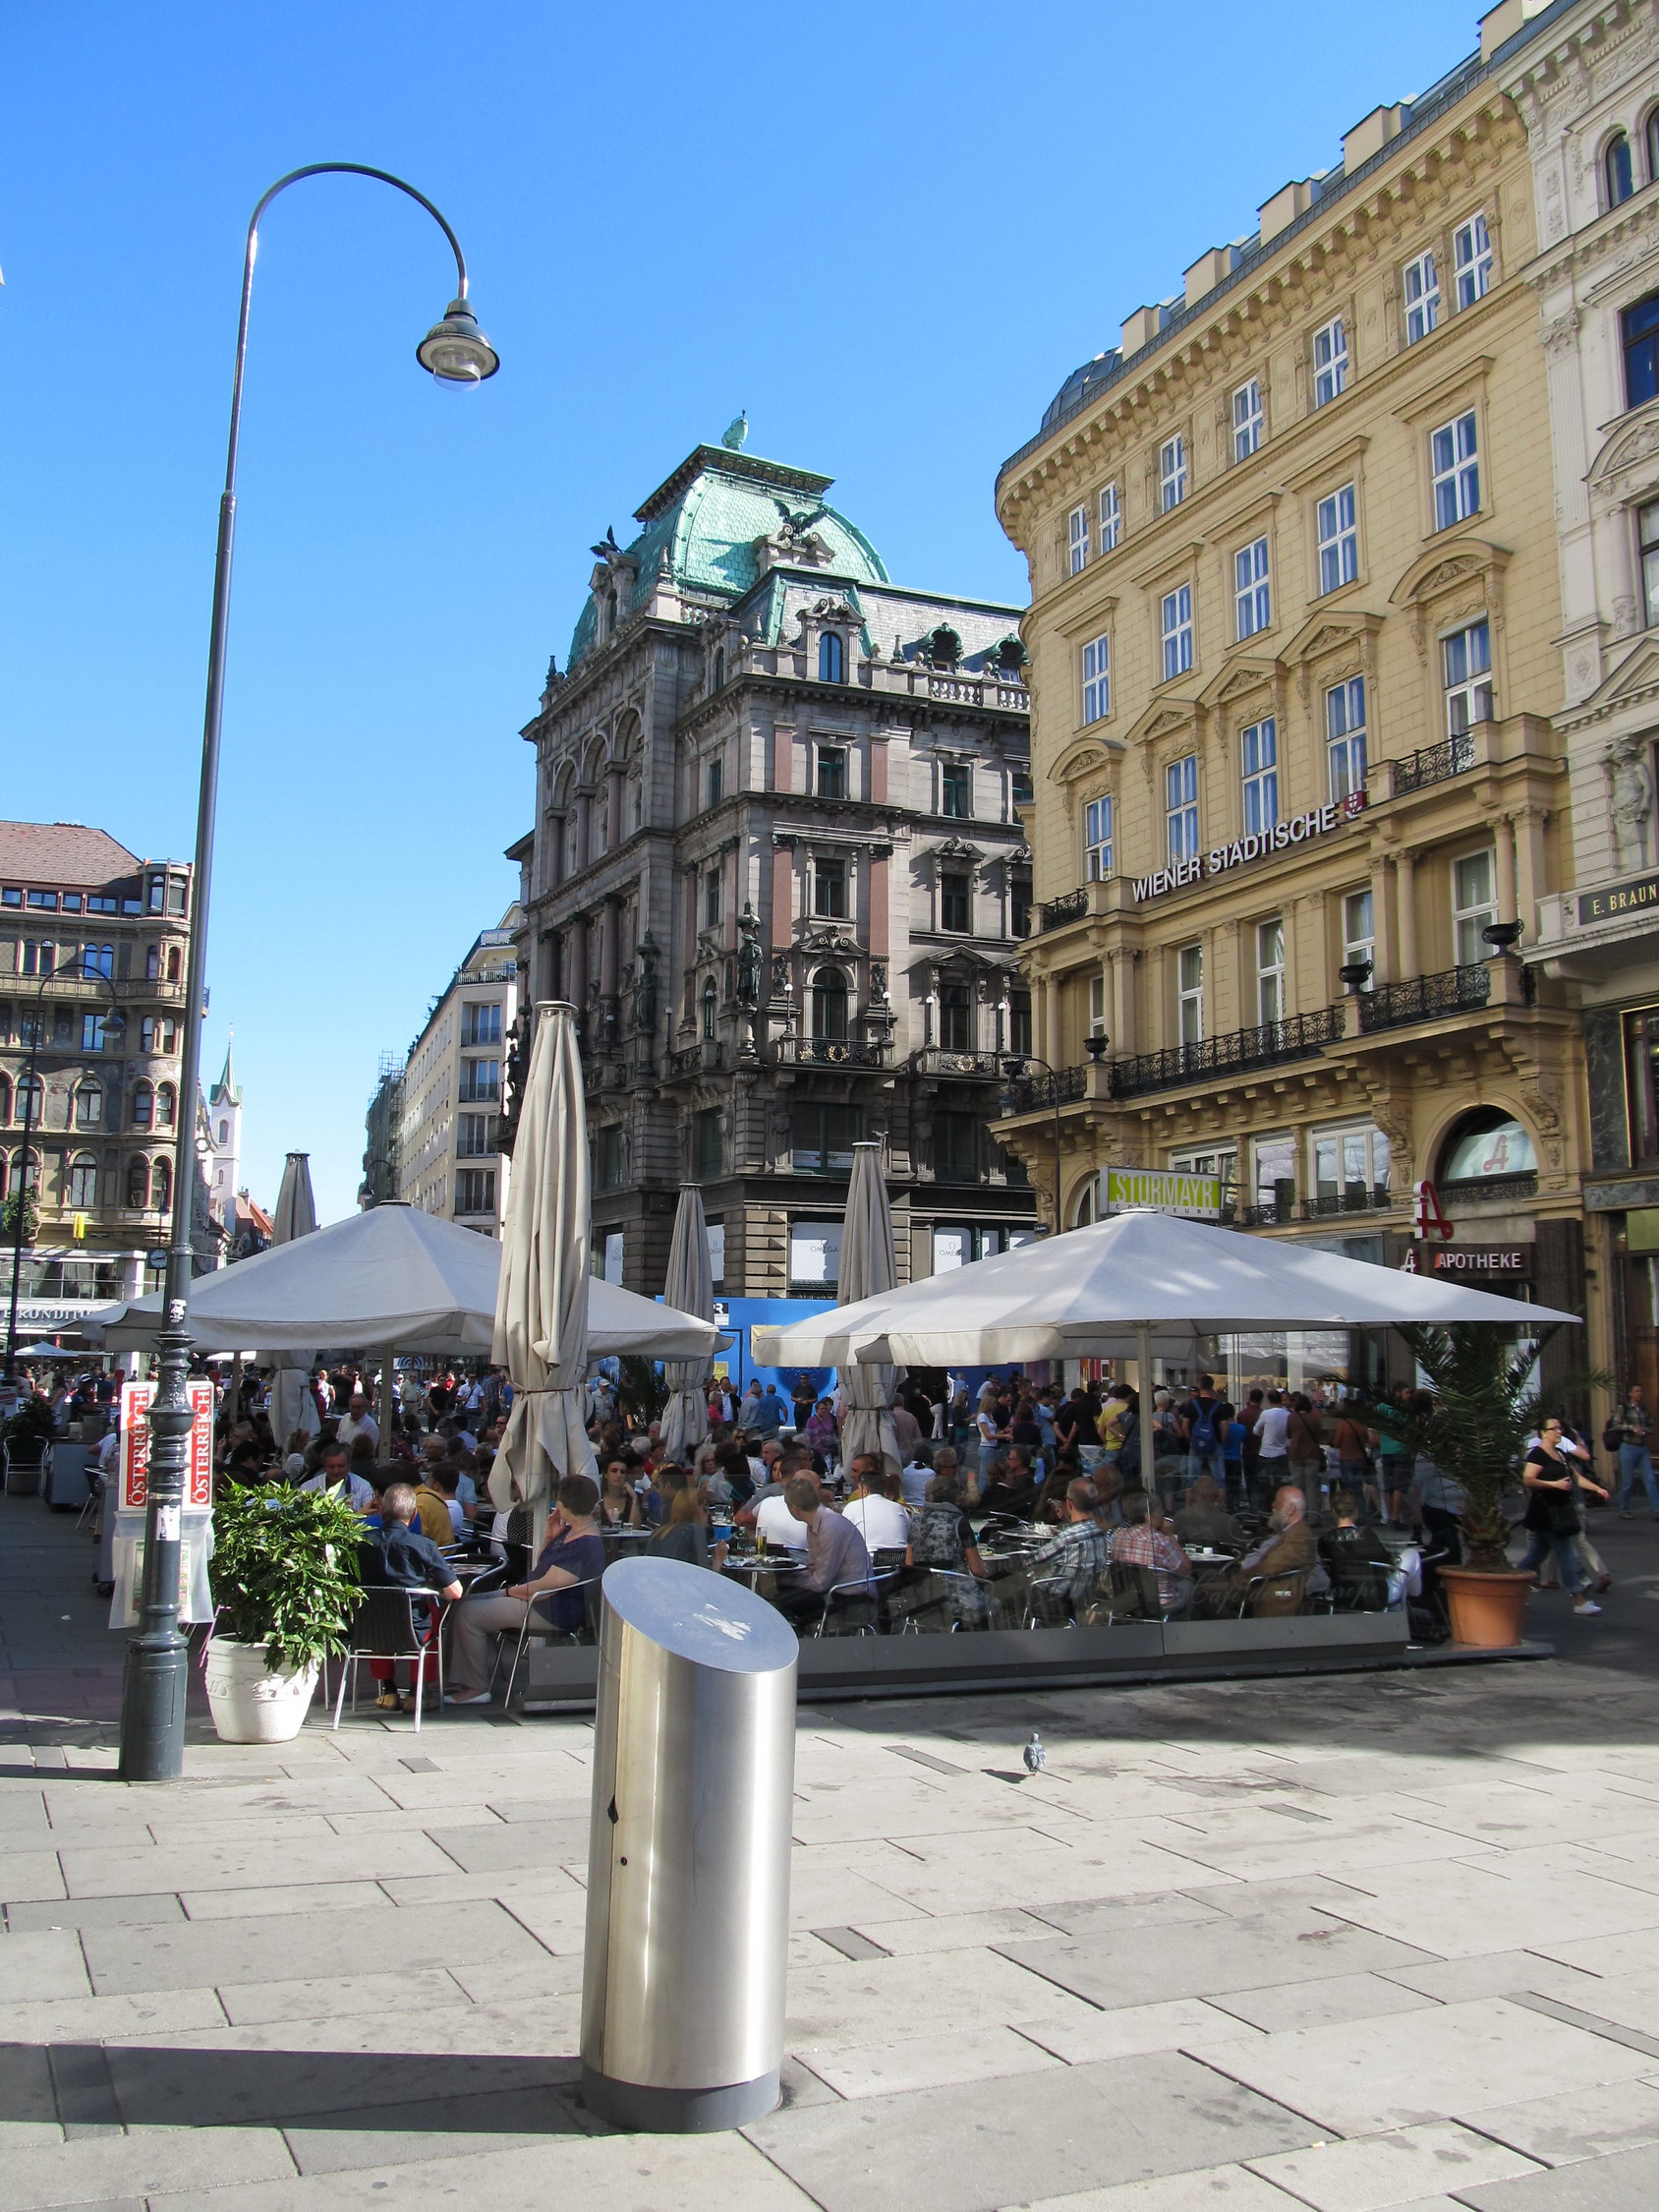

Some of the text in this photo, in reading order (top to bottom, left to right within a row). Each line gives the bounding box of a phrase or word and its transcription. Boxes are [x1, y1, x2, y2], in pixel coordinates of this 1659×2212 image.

[1131, 802, 1337, 903] WIENER STÄDTISCHE
[1592, 884, 1657, 915] E. BRAUN
[1116, 1173, 1214, 1208] STURMAYR
[810, 1245, 839, 1254] OMEGA
[1435, 1252, 1522, 1269] APOTHEKE
[192, 1389, 210, 1505] ÖSTERREICH
